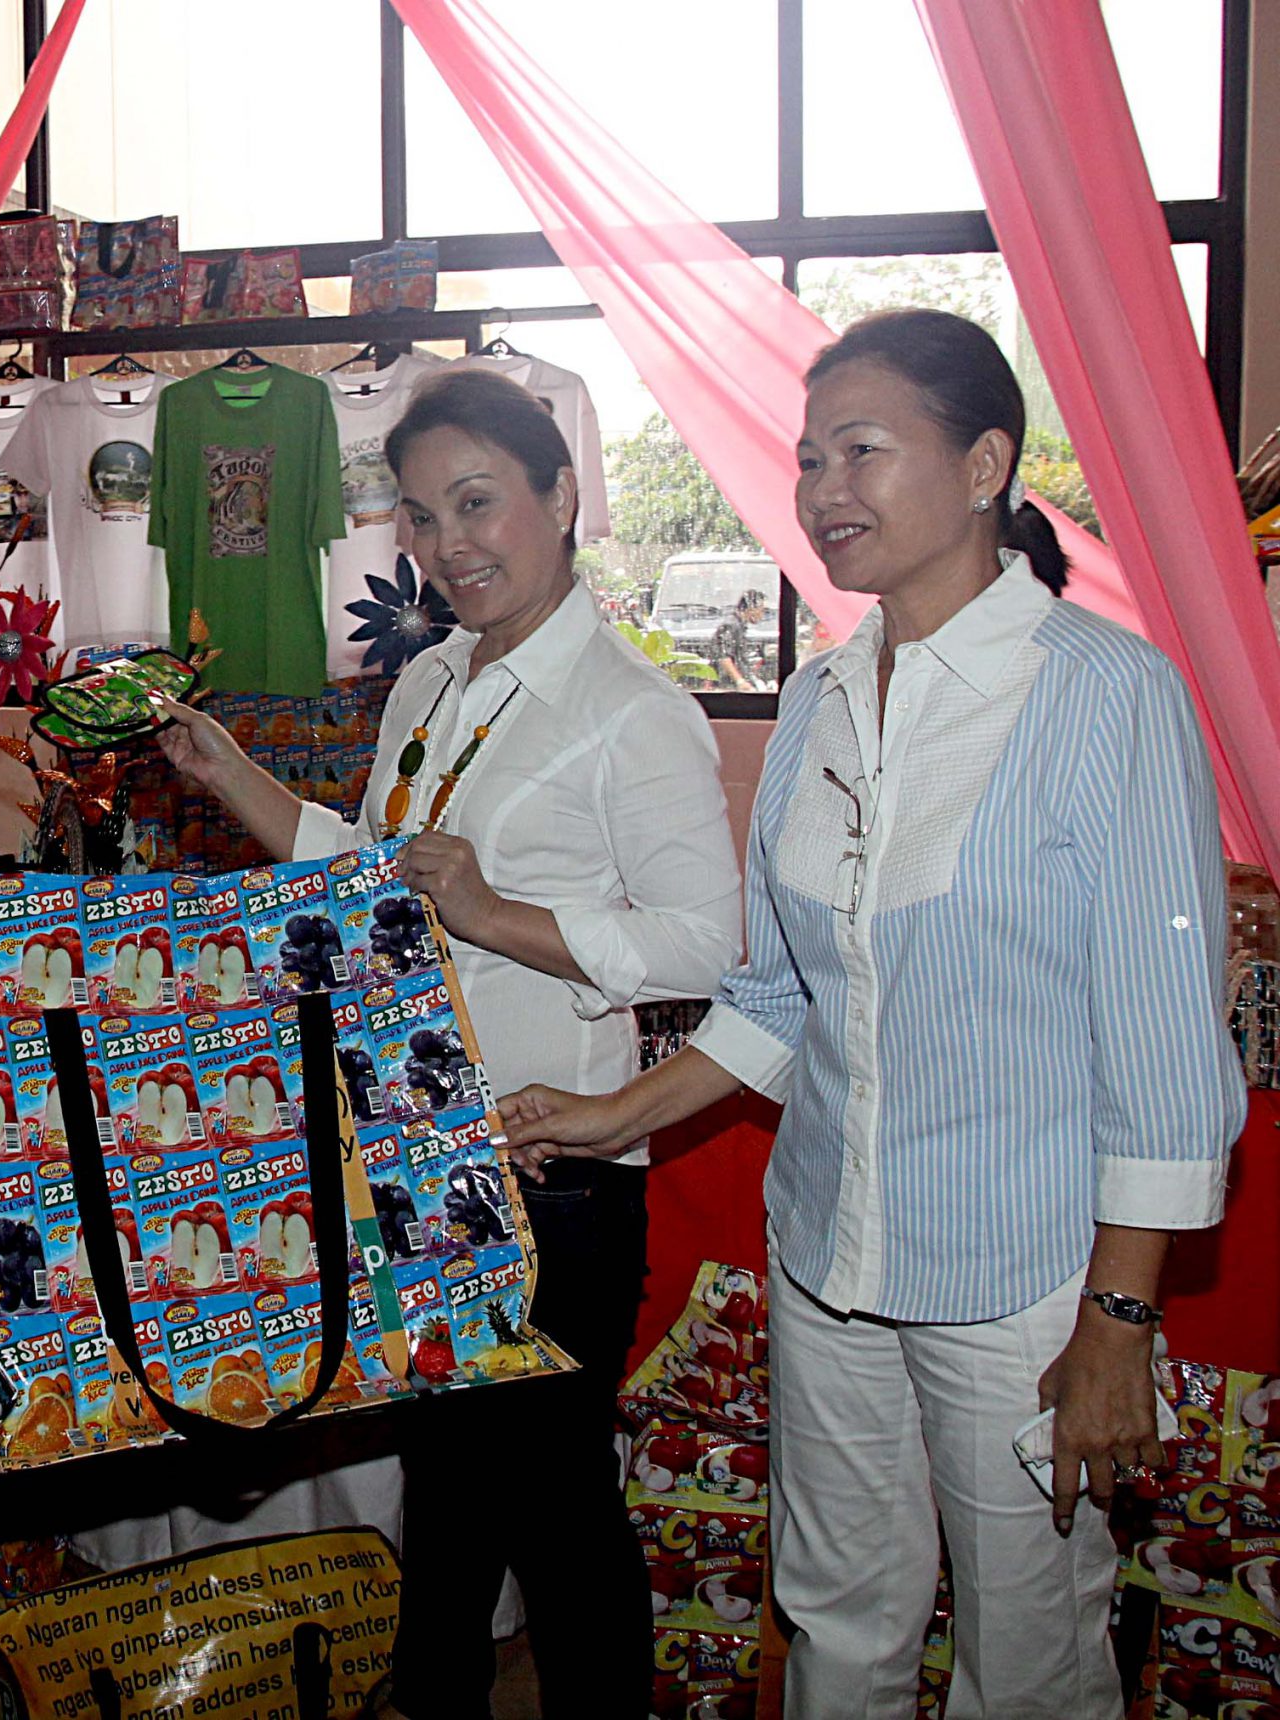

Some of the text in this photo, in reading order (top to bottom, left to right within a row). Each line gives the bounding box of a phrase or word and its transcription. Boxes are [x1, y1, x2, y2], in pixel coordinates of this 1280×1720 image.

[250, 911, 280, 927] GRAPE
[88, 926, 115, 938] APPLE
[109, 1062, 137, 1075] APPLE
[197, 1057, 223, 1070] APPLE
[18, 1066, 46, 1077] APPLE
[231, 1194, 258, 1208] APPLE
[141, 1203, 168, 1216] APPLE
[46, 1210, 75, 1224] APPLE
[0, 1551, 385, 1653] 3. Ngaran ngan address han health
[331, 1613, 397, 1645] center
[38, 1657, 75, 1684] nga
[193, 1673, 284, 1715] address
